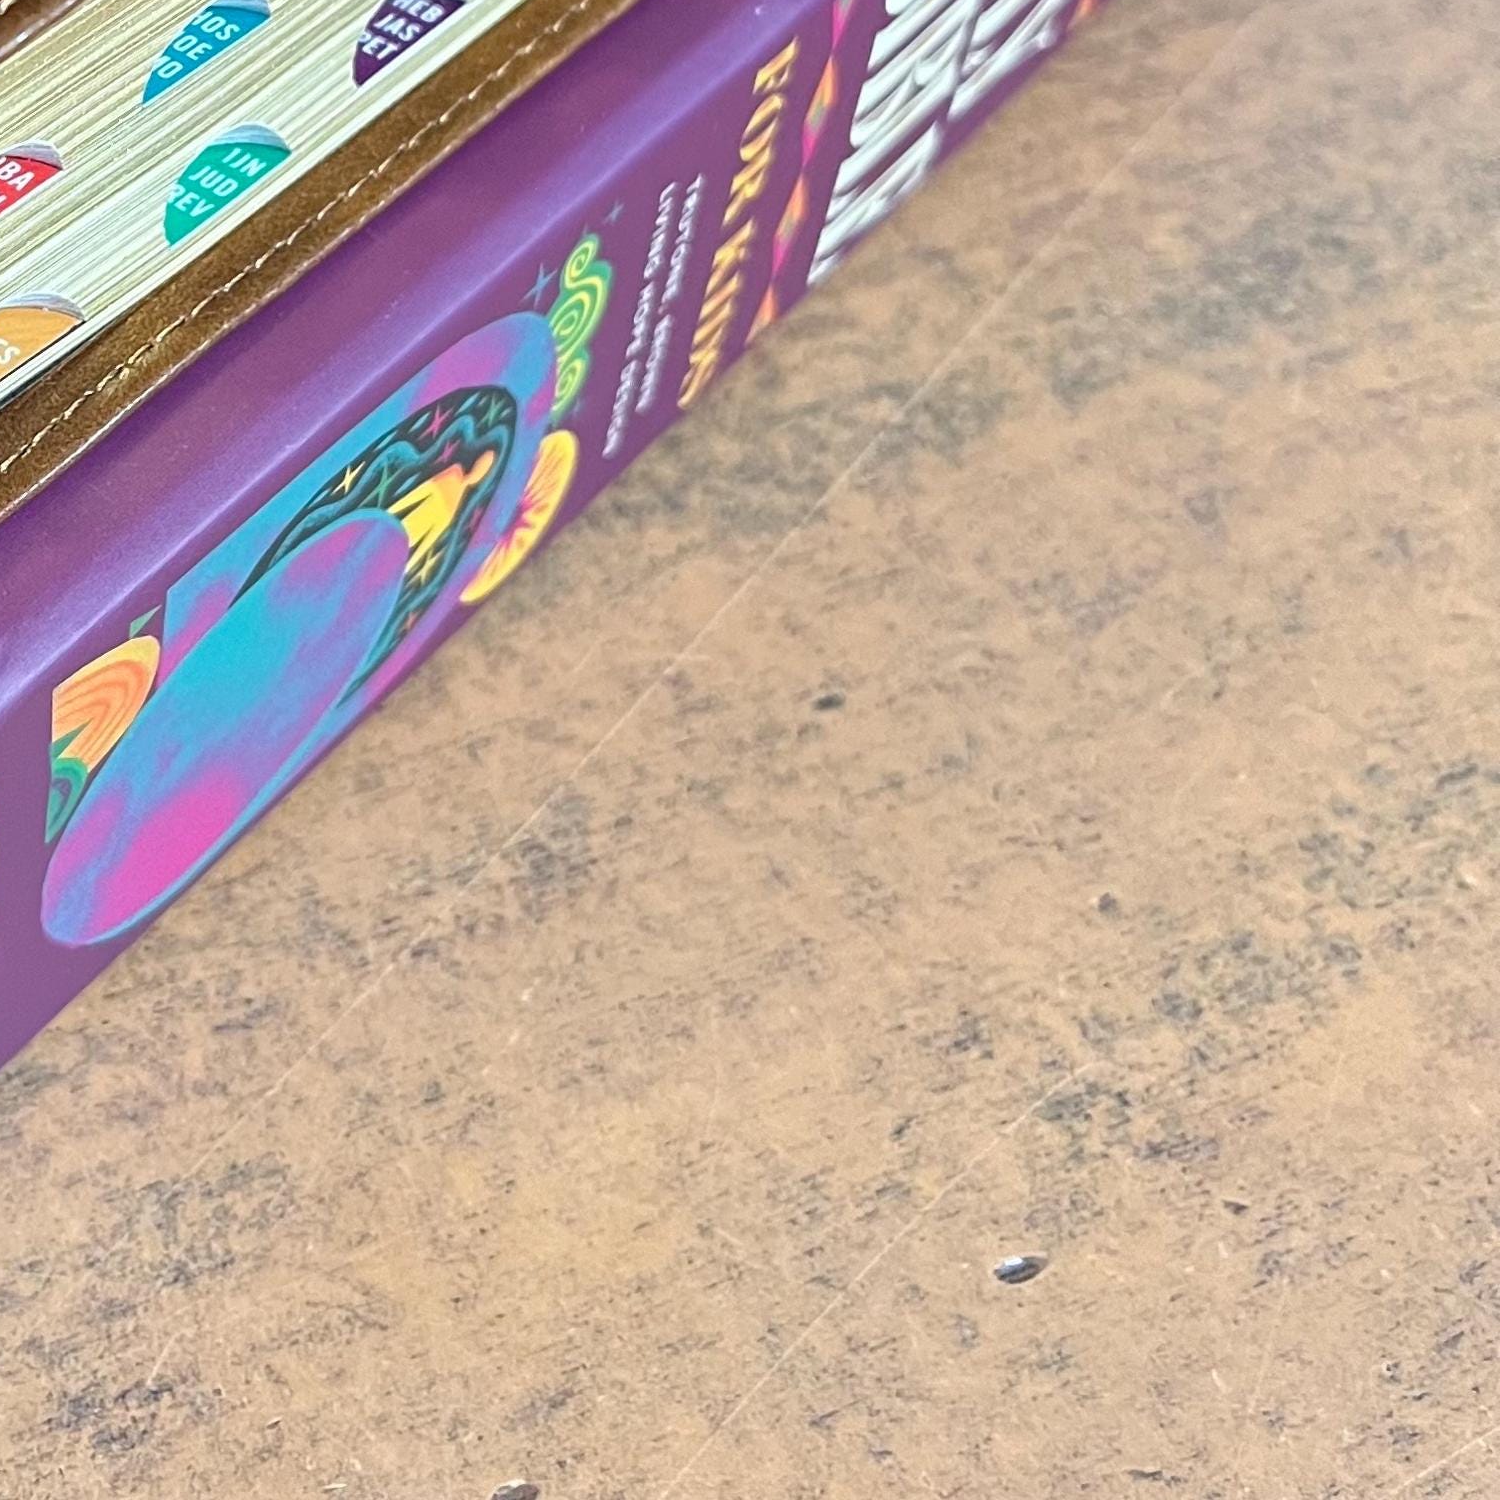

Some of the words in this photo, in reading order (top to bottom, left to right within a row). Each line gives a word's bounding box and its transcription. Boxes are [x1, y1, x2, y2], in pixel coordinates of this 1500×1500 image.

[173, 33, 214, 61] OE
[373, 13, 421, 42] JAS
[721, 37, 797, 227] FOR
[188, 165, 239, 197] JUD
[644, 181, 678, 280] LIVING
[626, 281, 656, 359] HOPE
[677, 216, 756, 410] KIDS
[602, 360, 641, 458] DESIGN
